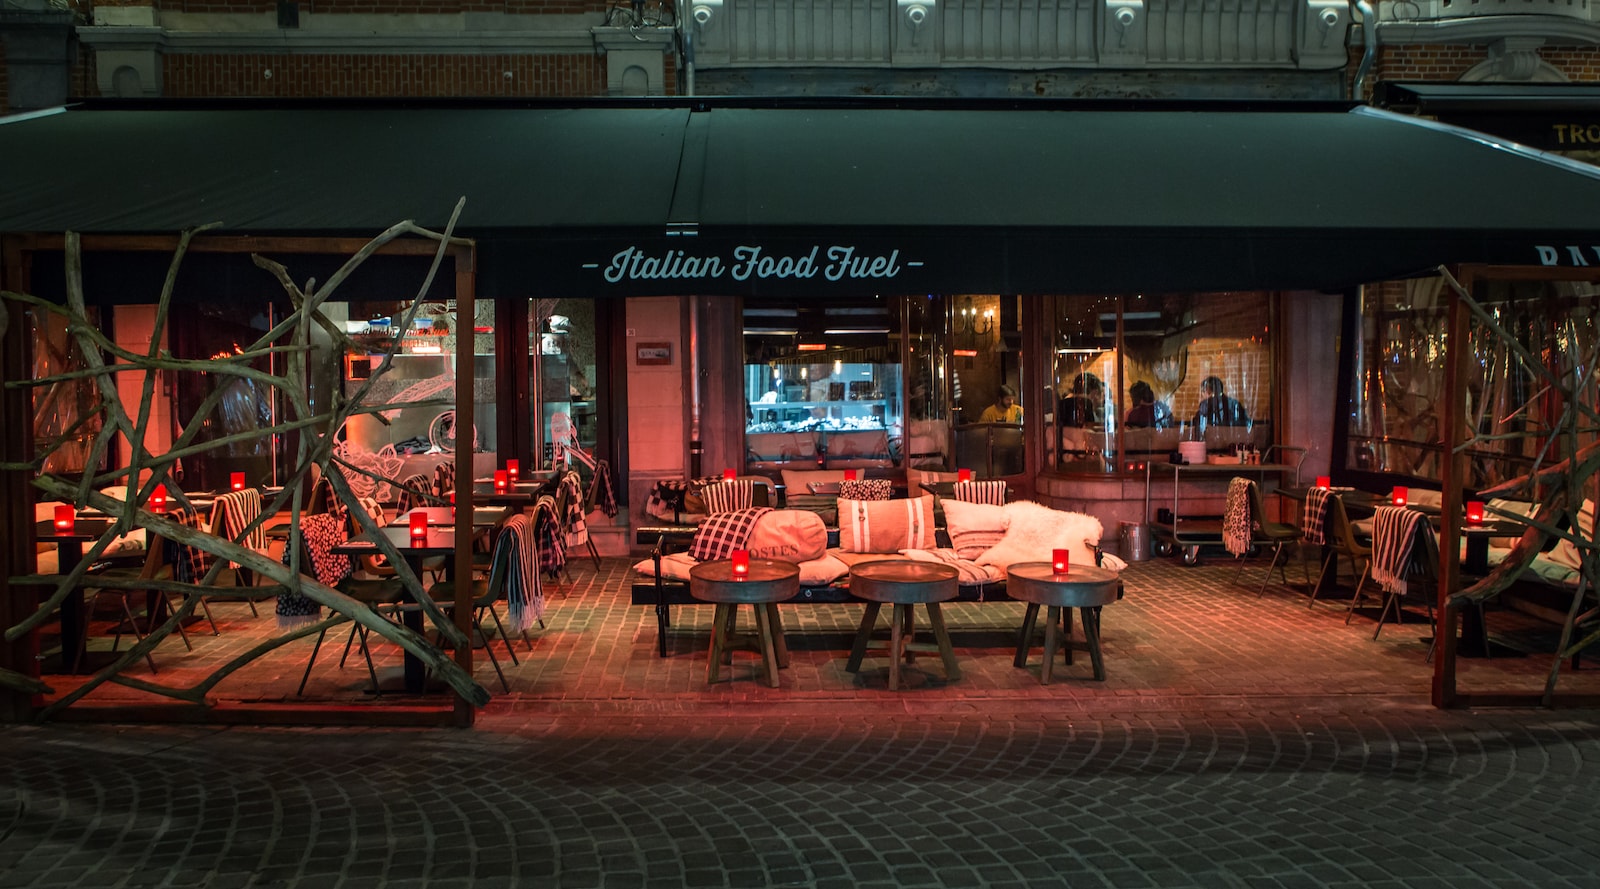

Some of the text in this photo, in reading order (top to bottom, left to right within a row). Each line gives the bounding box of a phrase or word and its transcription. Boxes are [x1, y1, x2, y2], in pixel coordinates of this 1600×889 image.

[603, 245, 900, 283] Italian Food Fuel
